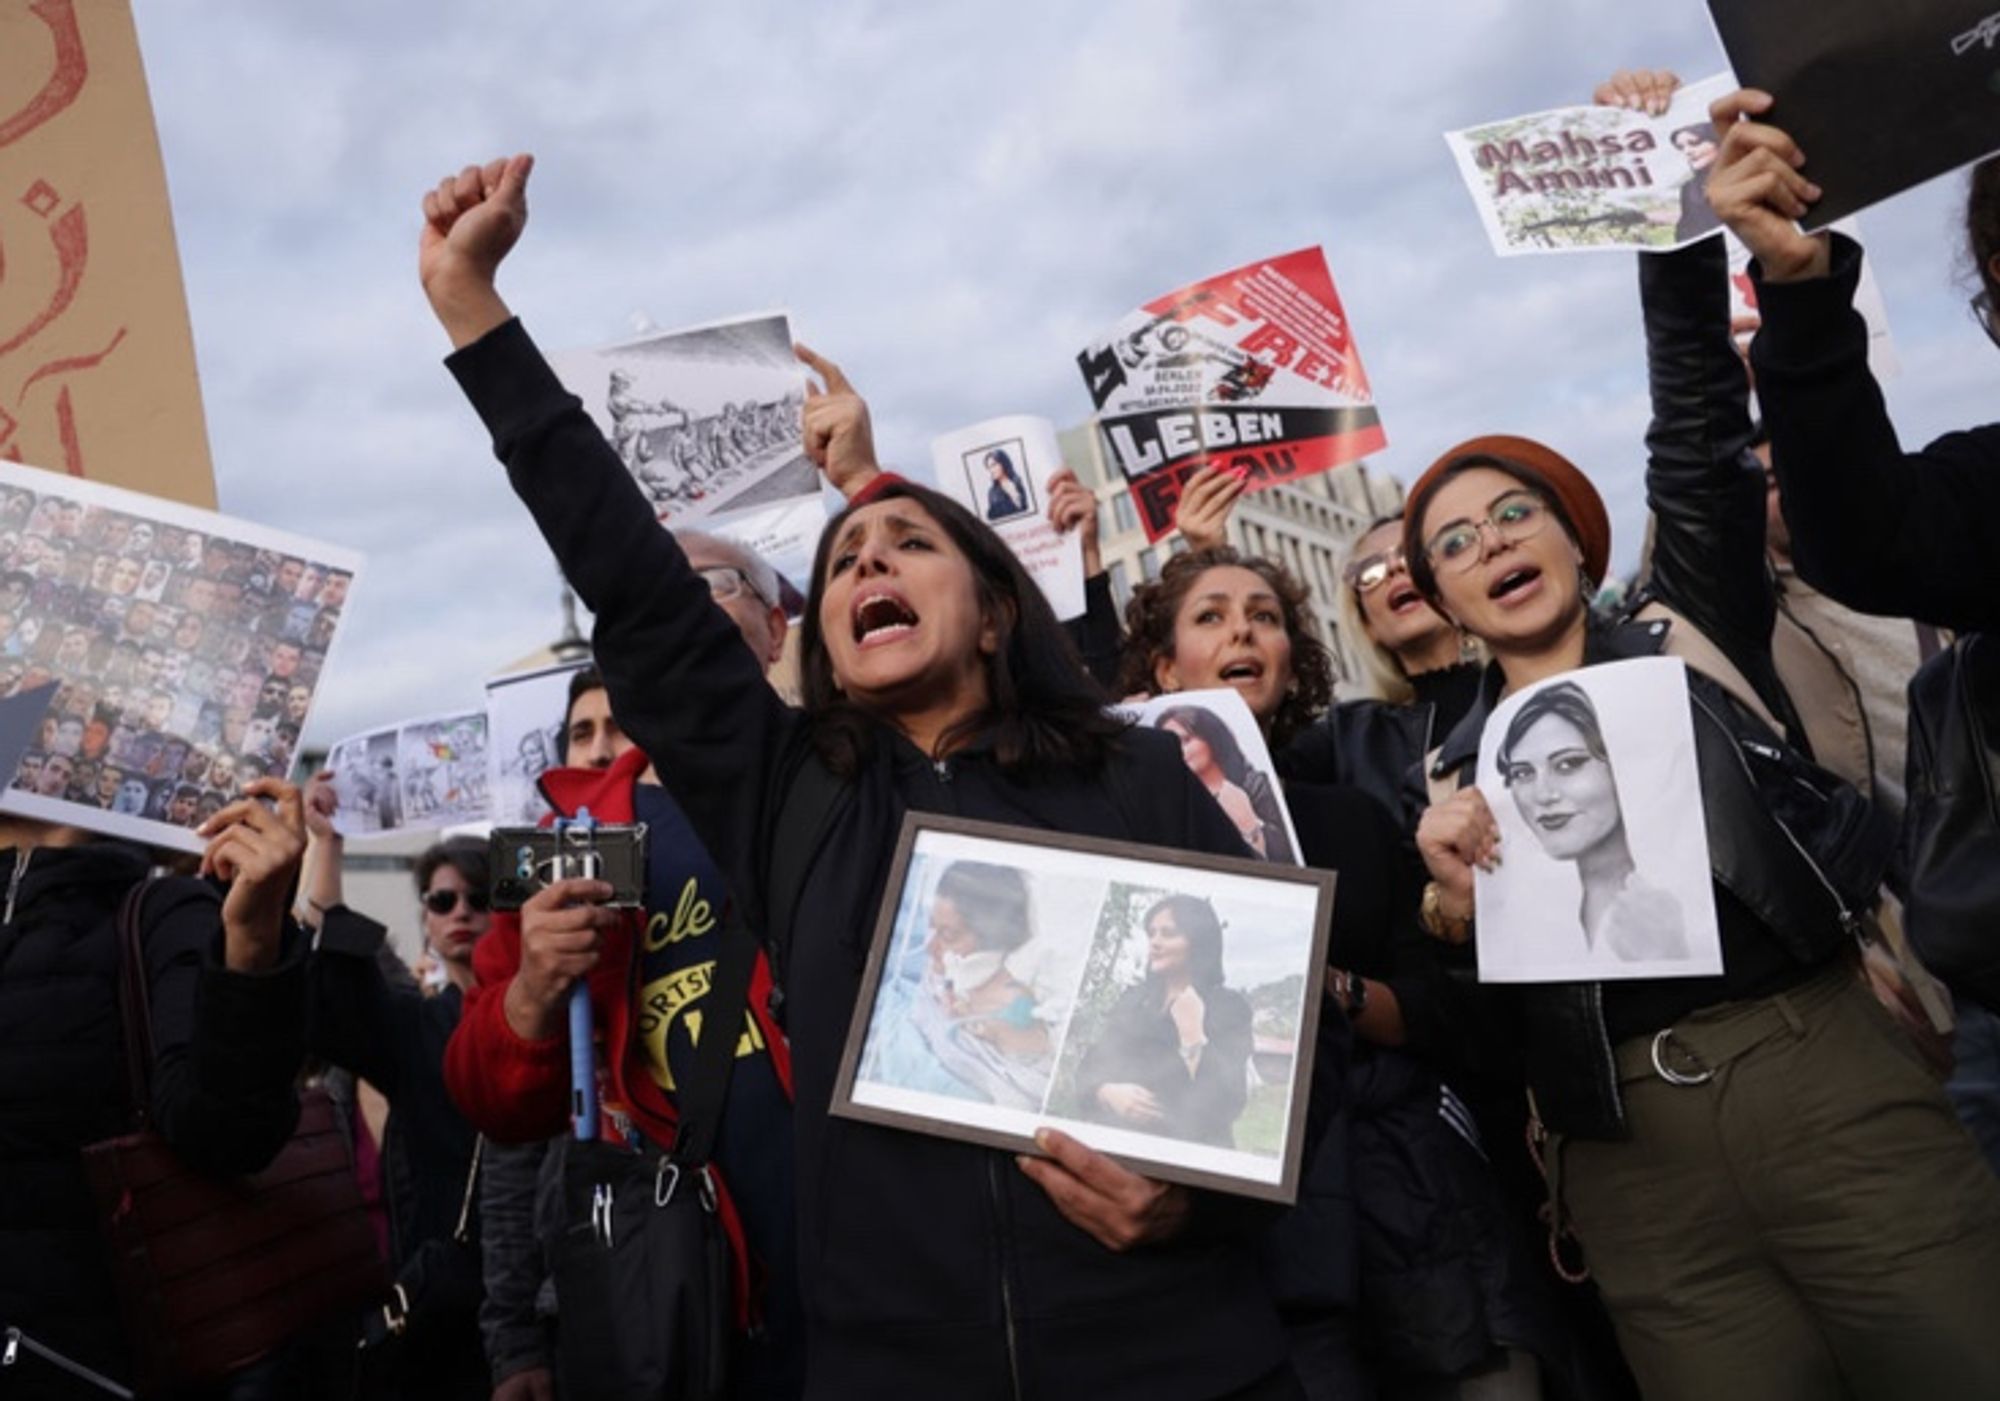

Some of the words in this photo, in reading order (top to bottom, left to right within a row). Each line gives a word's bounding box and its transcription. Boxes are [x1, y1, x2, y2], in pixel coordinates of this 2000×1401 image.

[1478, 129, 1656, 169] Mahsa
[1496, 158, 1654, 196] Amini
[1110, 413, 1284, 477] LEBEN
[1140, 448, 1299, 532] FAU
[645, 877, 716, 951] cle
[640, 965, 716, 1034] ORTS
